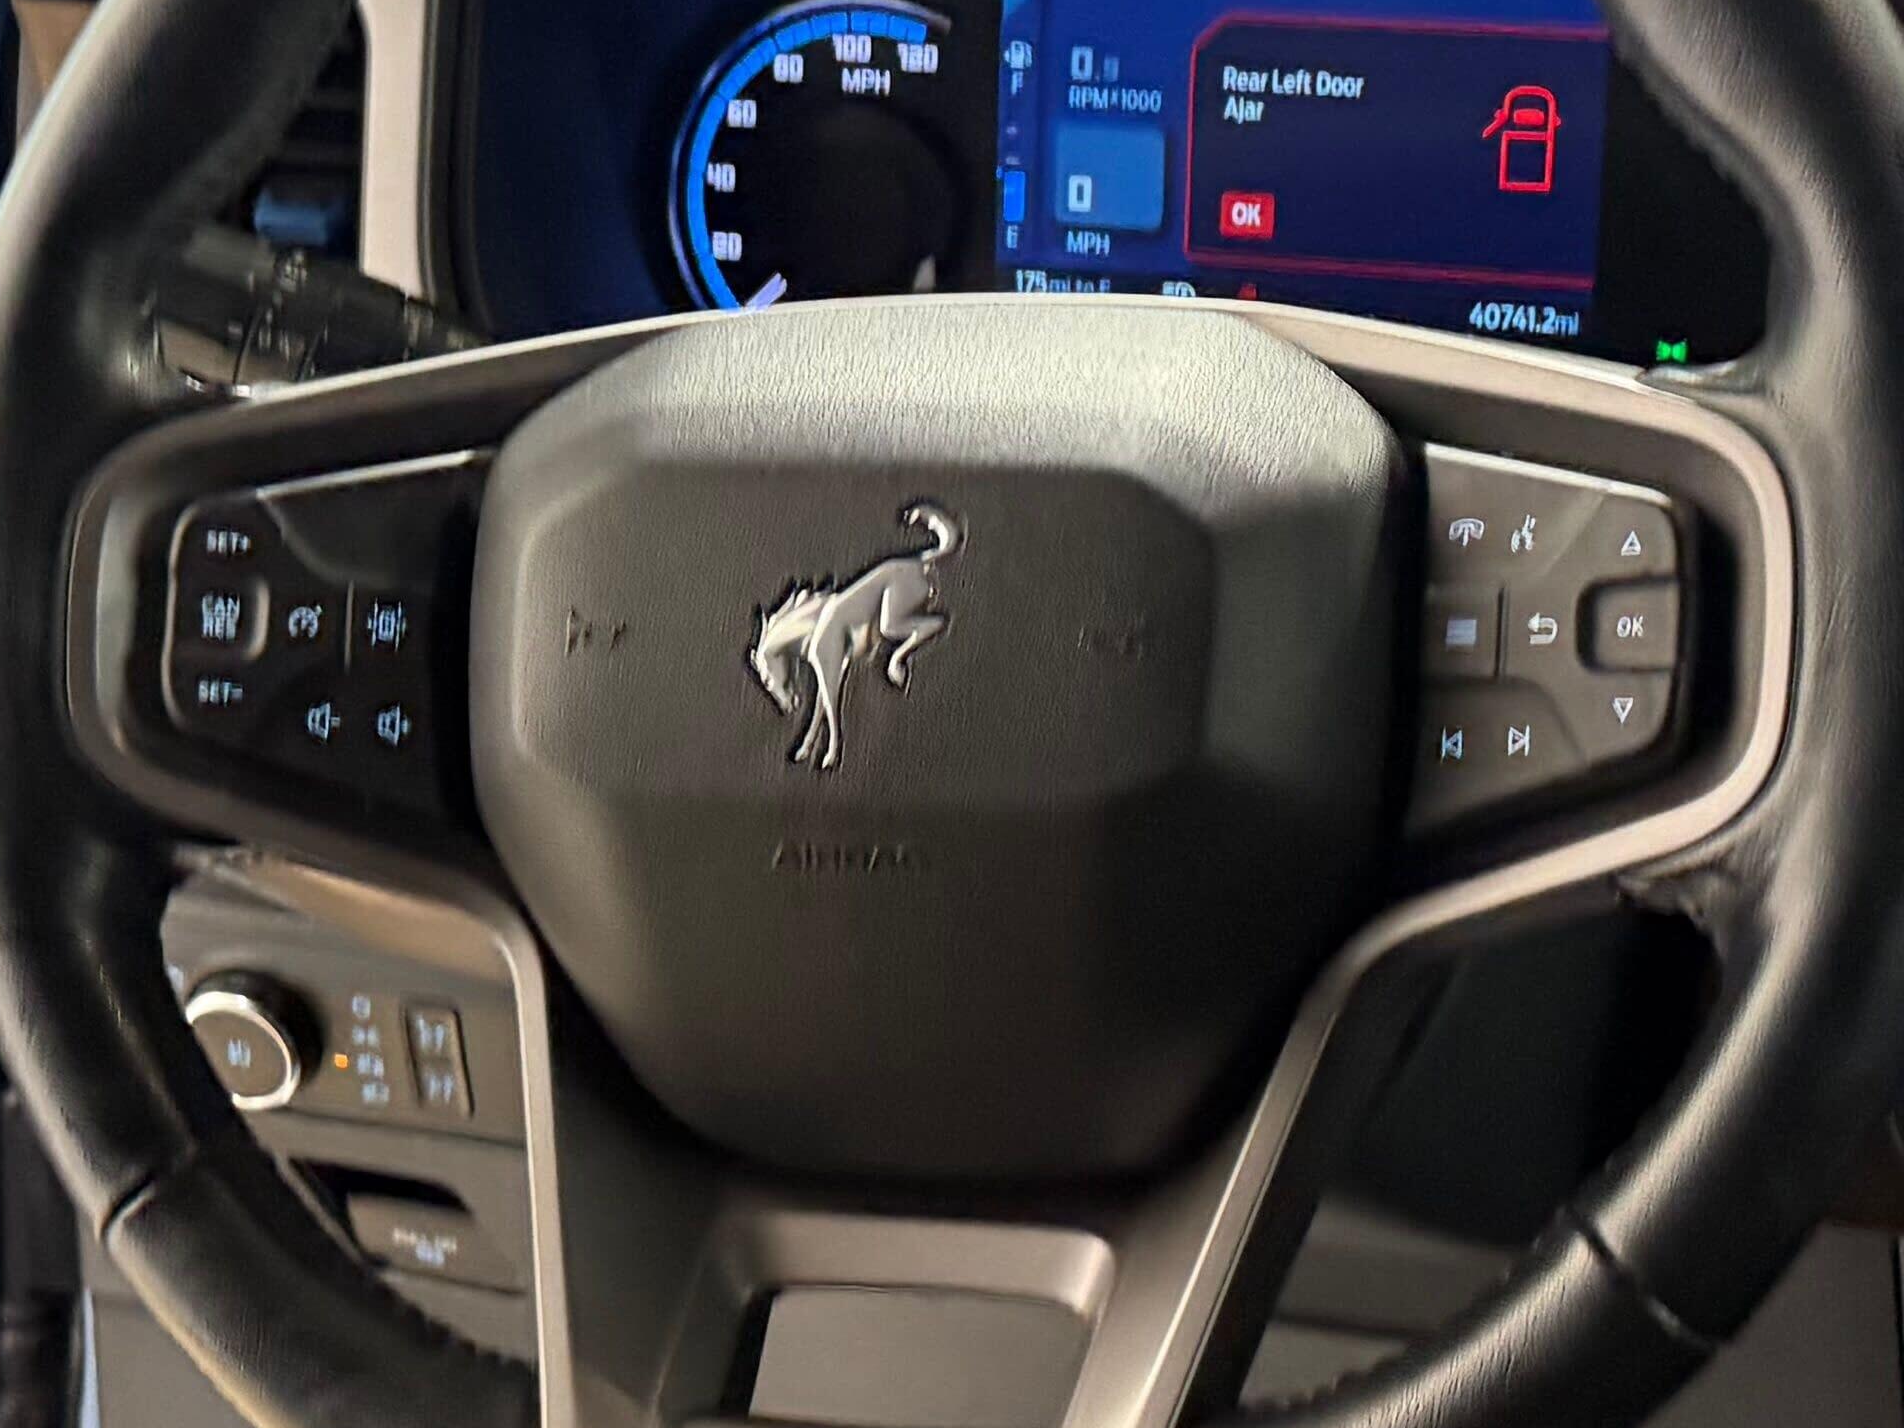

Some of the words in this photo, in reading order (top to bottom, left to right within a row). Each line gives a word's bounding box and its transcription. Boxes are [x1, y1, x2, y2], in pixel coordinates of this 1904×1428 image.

[841, 68, 892, 97] MPH
[1223, 65, 1269, 94] Rear
[1272, 68, 1312, 96] Left
[1315, 70, 1365, 99] Door
[1223, 95, 1265, 125] Ajar
[706, 162, 736, 193] 40
[1067, 174, 1093, 213] 0
[1231, 200, 1262, 227] OK
[1066, 229, 1111, 257] MPH
[1616, 615, 1645, 639] OK
